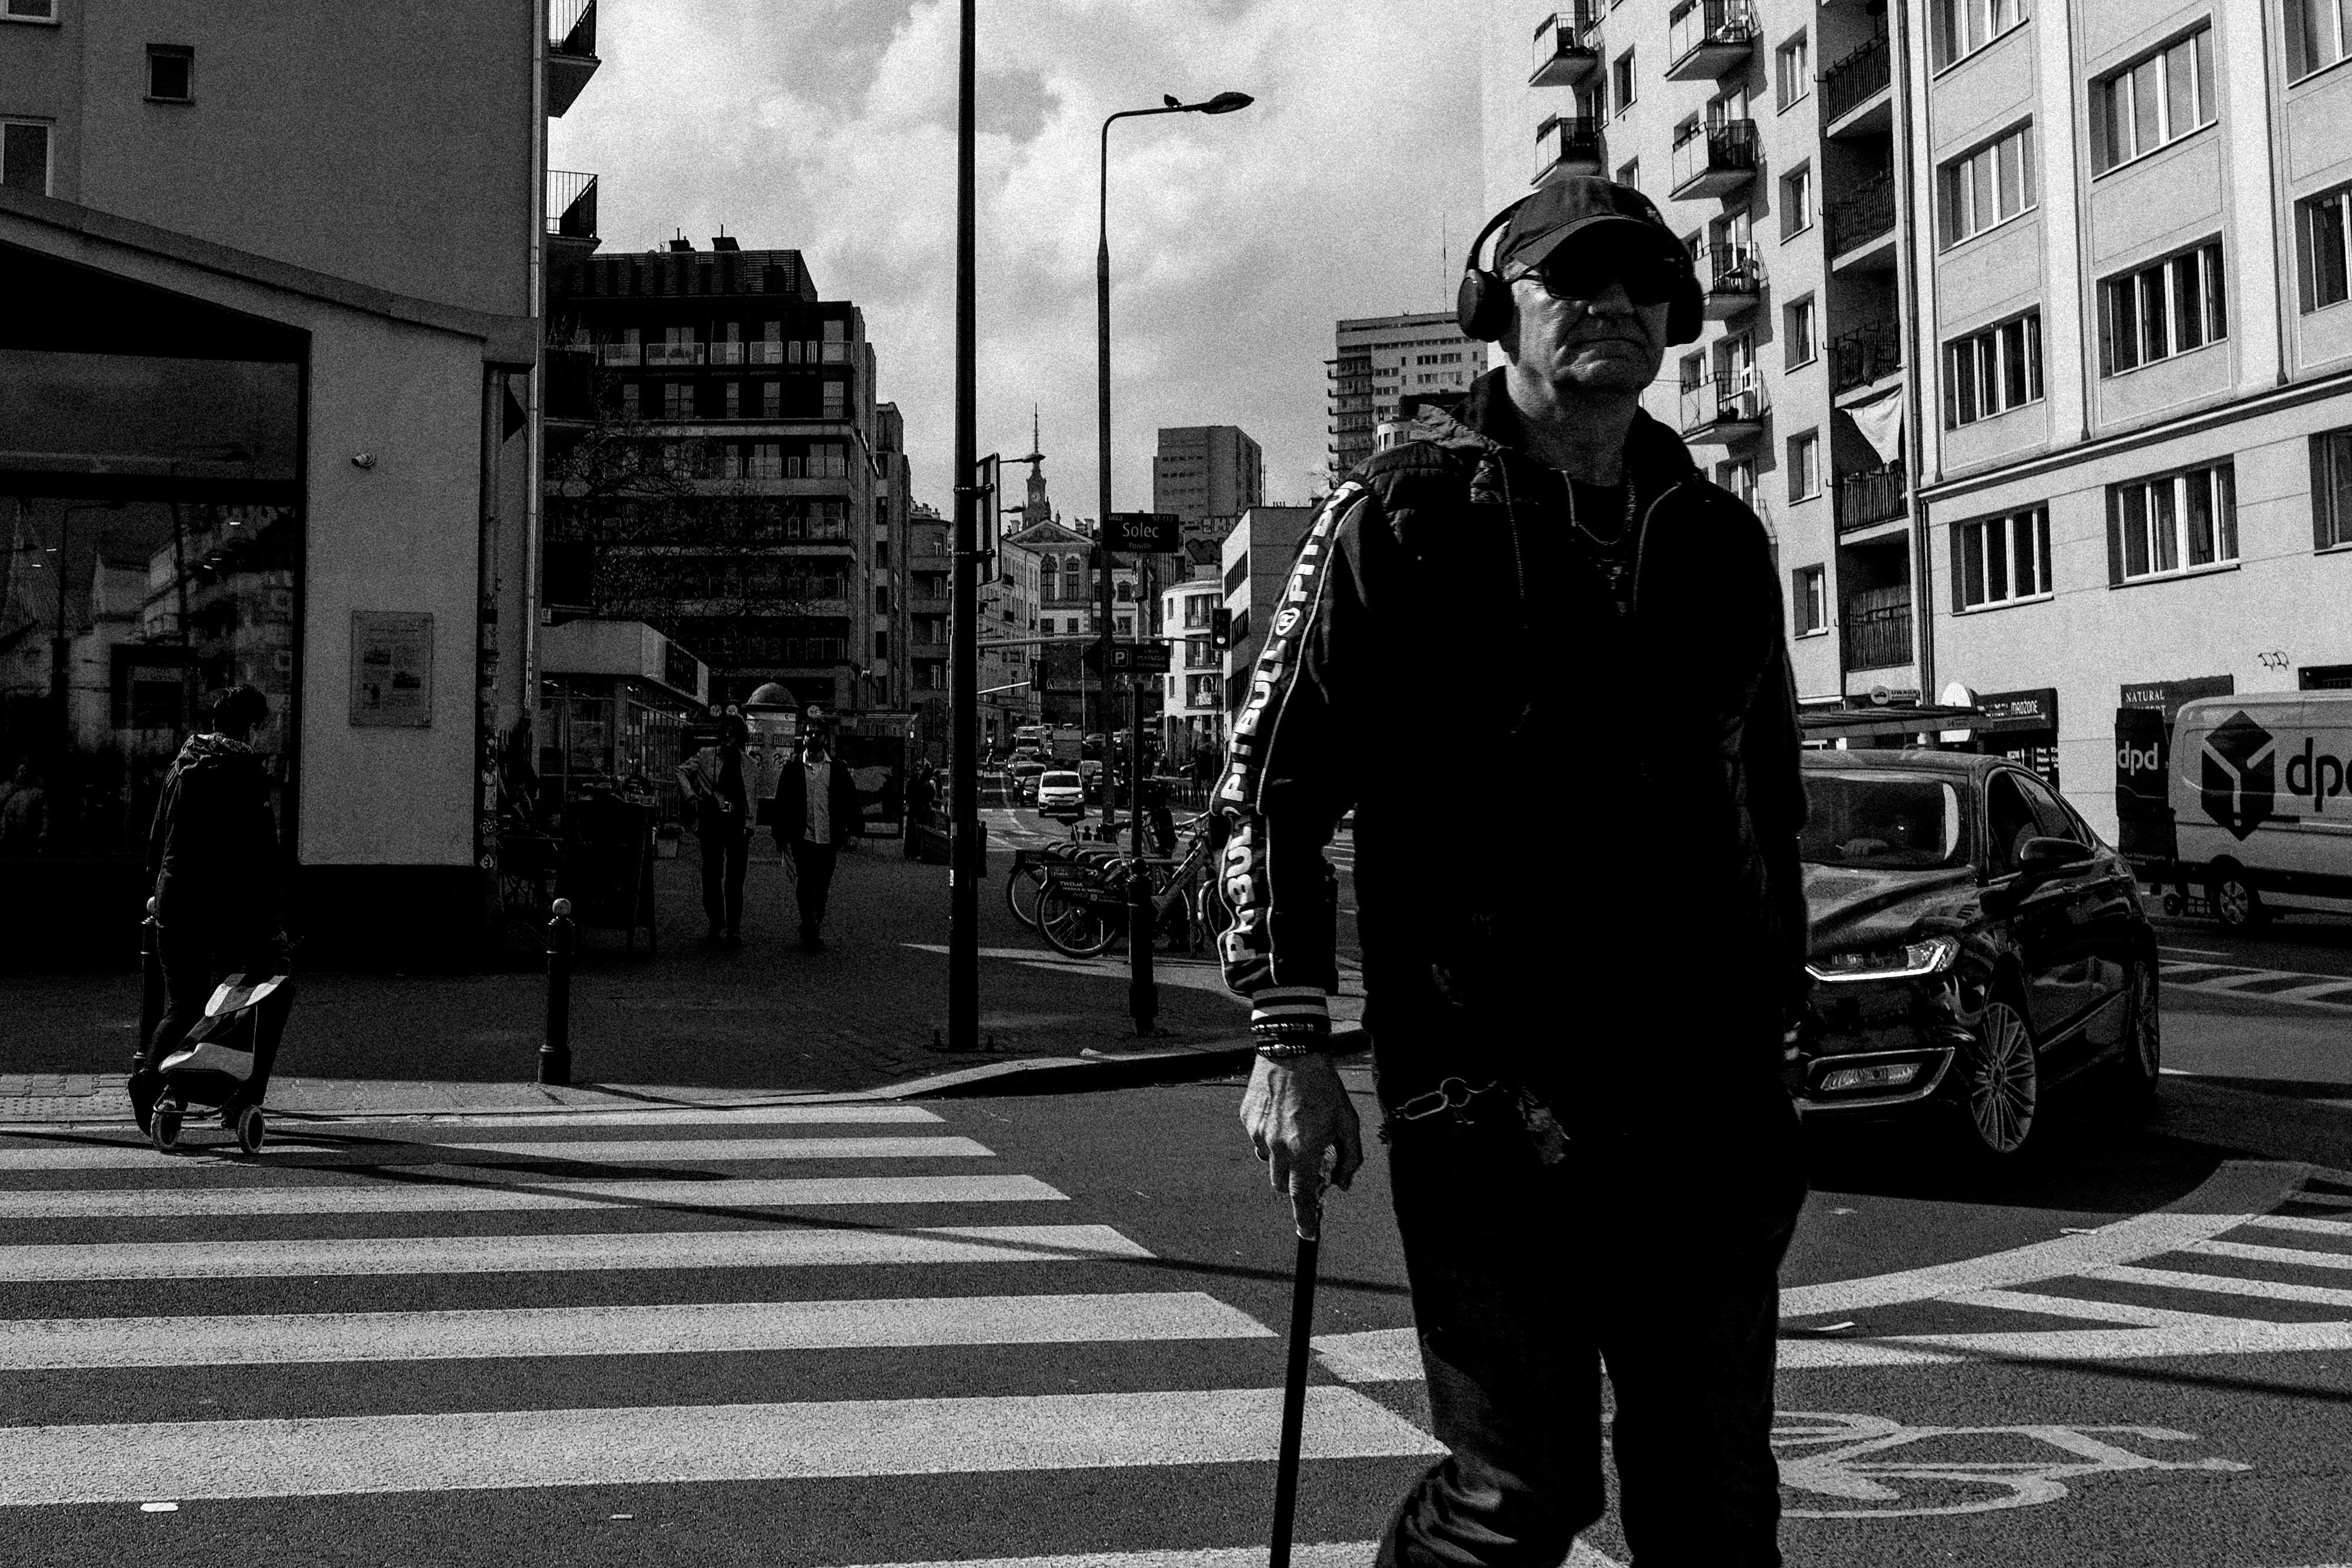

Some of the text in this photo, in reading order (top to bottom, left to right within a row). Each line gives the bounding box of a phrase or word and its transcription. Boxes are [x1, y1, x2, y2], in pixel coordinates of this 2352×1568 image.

[1122, 521, 1159, 538] Solec
[1115, 651, 1125, 664] P
[2126, 689, 2165, 703] NATURAL
[2117, 741, 2159, 777] dpd
[2285, 737, 2352, 813] dp
